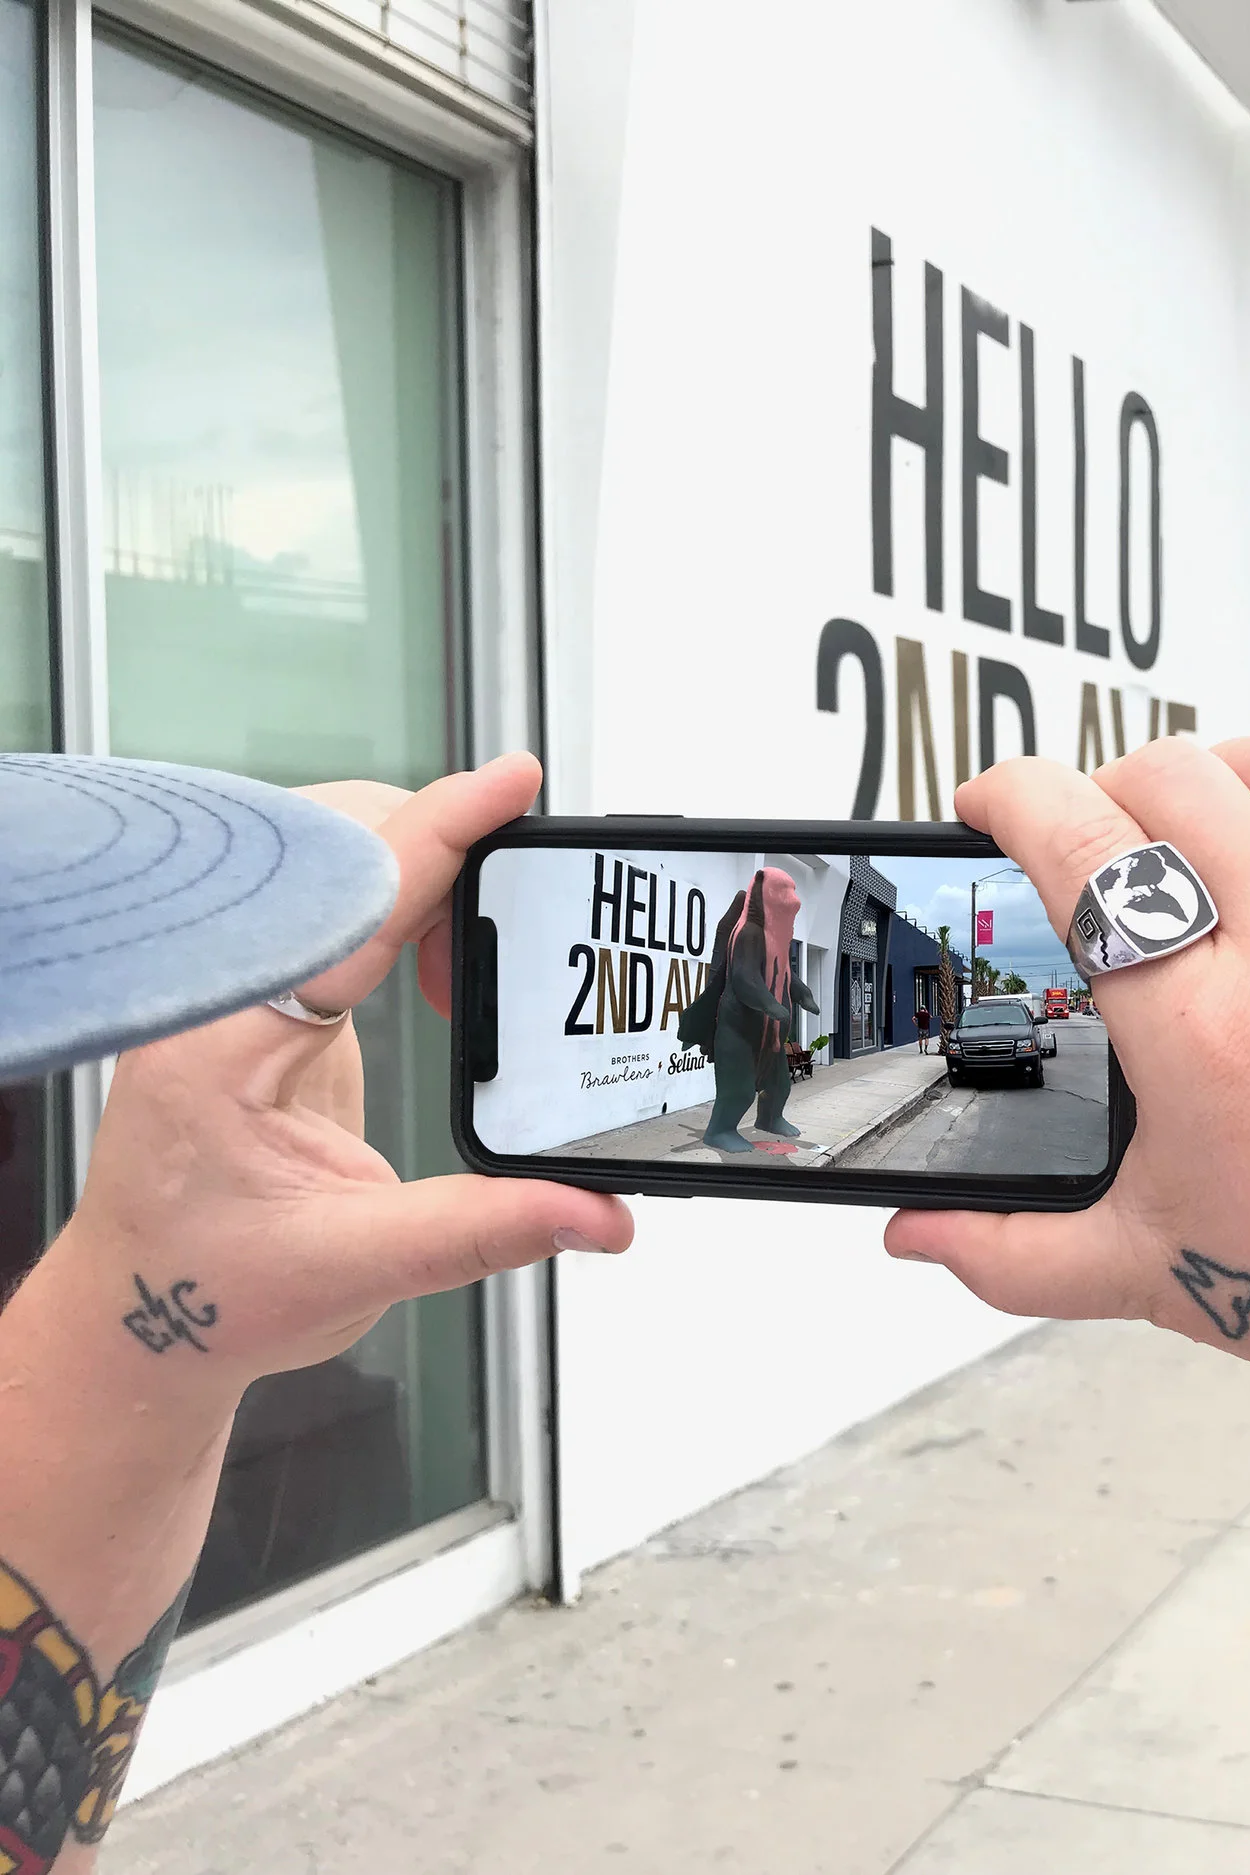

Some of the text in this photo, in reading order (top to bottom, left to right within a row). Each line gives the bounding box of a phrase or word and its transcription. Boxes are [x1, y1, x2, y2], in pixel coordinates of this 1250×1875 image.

[870, 224, 1161, 672] HELLO
[816, 616, 1037, 821] 2N
[591, 852, 706, 957] HELLO
[564, 943, 712, 1036] 2ND AV
[580, 1052, 706, 1089] Brawlers Selina
[611, 1053, 650, 1066] BROTHERS
